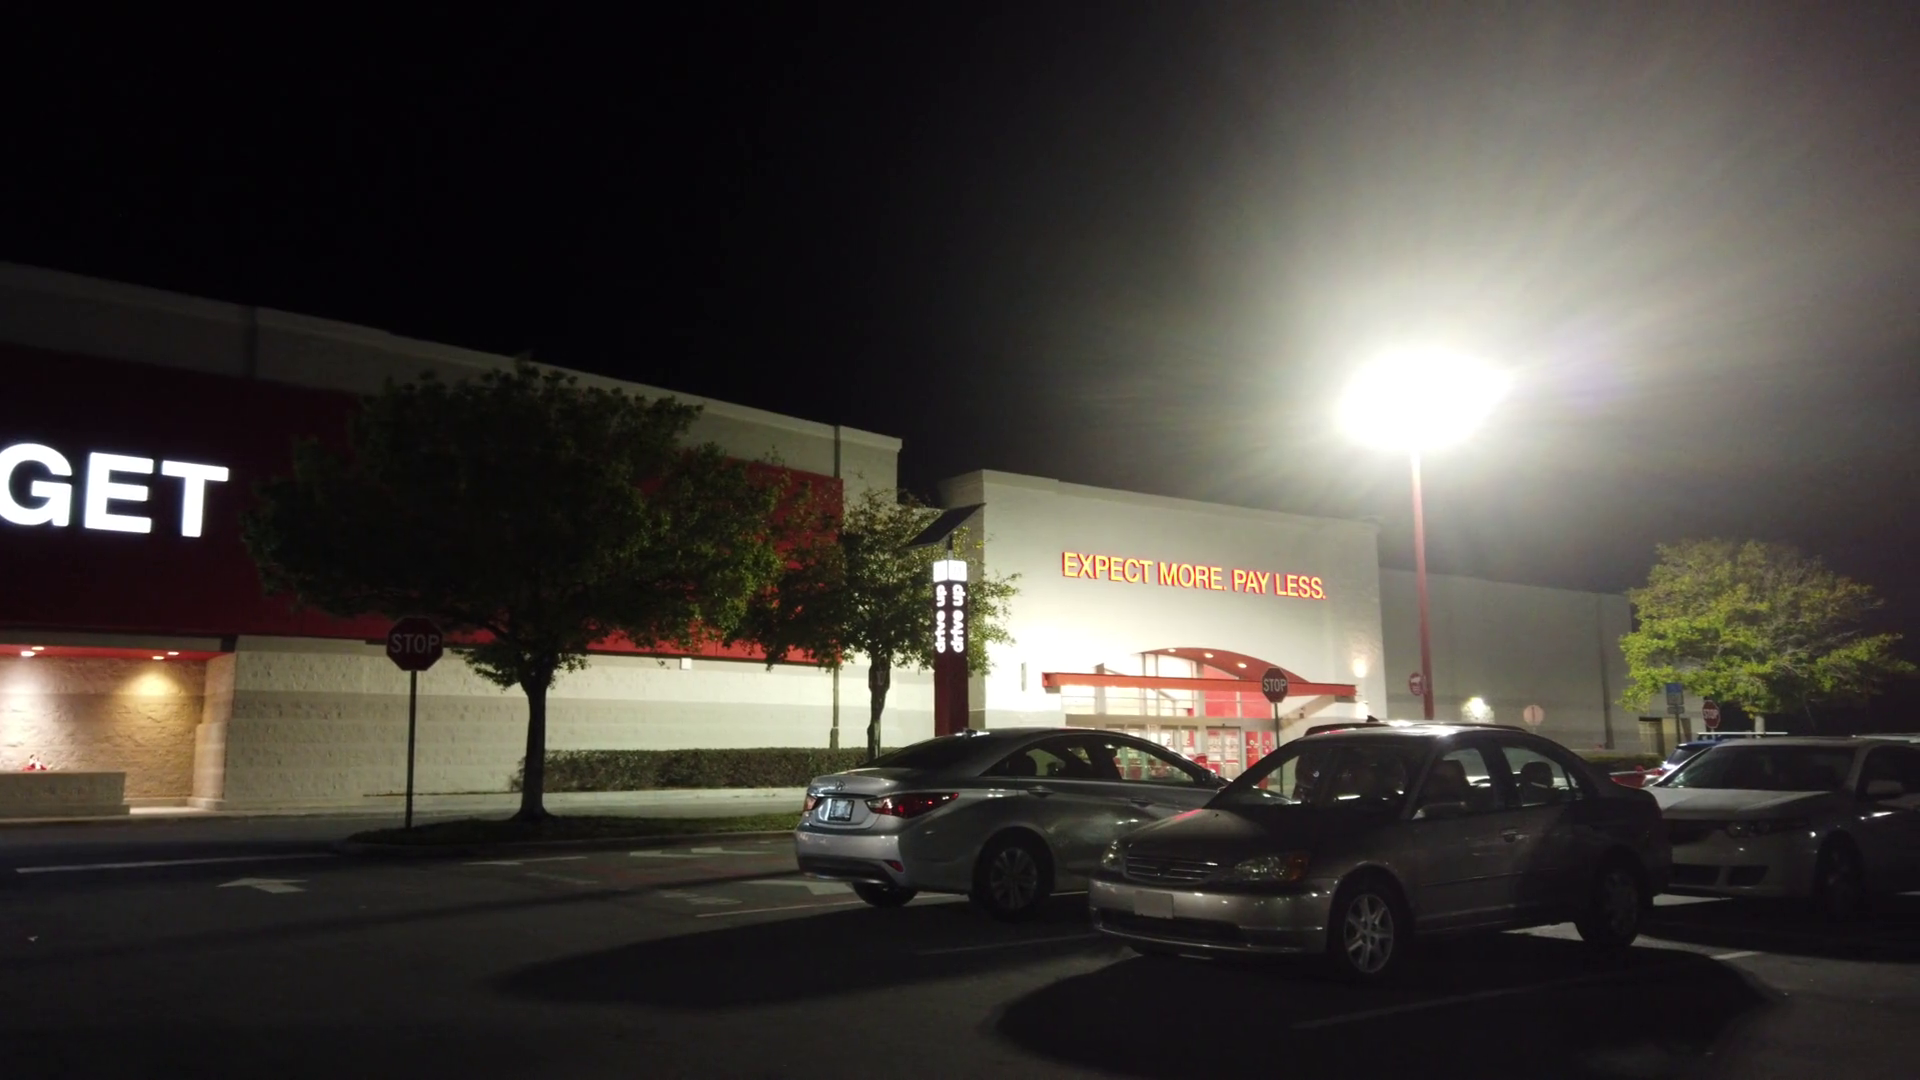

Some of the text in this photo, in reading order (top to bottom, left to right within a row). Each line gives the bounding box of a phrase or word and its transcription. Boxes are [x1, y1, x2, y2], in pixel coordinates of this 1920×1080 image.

[1062, 551, 1326, 599] EXPECT MORE. PAY LESS.
[935, 584, 947, 653] drive up
[951, 584, 966, 653] drive up
[391, 633, 439, 654] STOP
[1263, 678, 1286, 692] STOP
